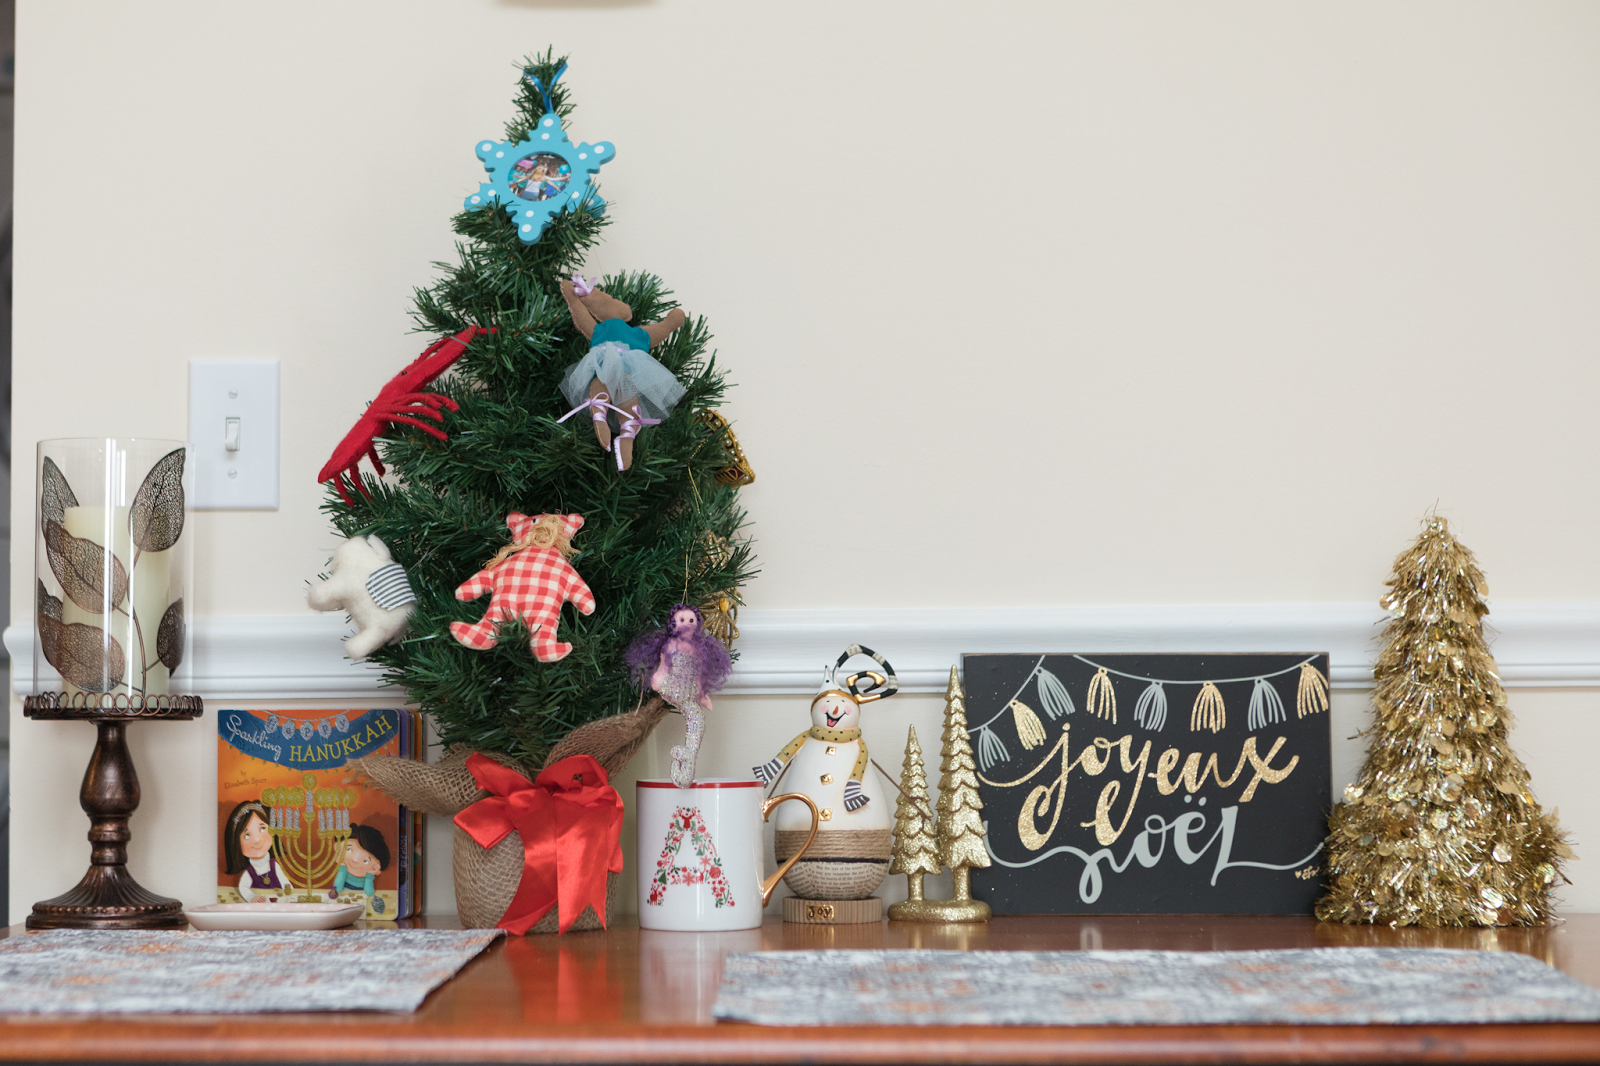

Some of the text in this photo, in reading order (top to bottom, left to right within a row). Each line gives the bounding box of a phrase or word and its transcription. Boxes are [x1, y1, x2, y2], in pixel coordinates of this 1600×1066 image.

[226, 714, 393, 763] Sparkling HANUKKAH
[977, 722, 1300, 851] joyeux
[647, 805, 735, 908] A
[808, 905, 832, 919] Joy
